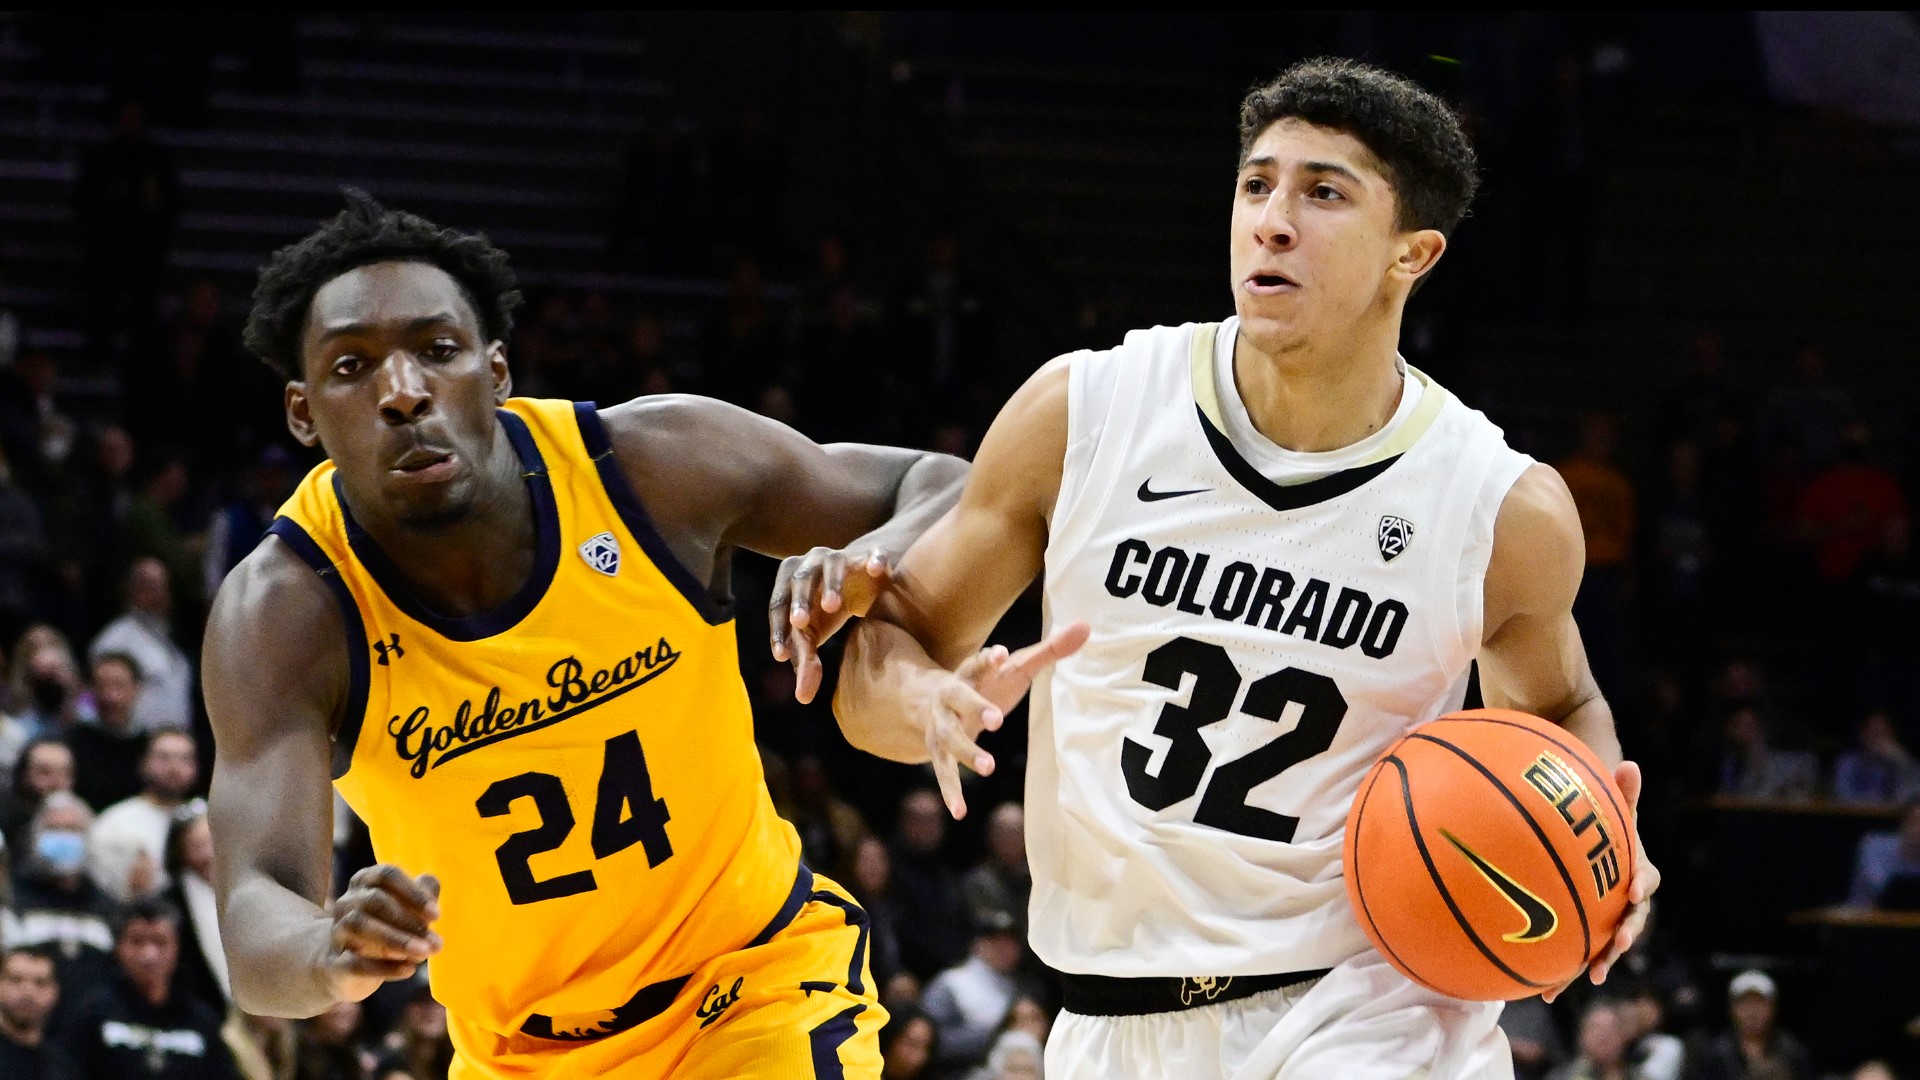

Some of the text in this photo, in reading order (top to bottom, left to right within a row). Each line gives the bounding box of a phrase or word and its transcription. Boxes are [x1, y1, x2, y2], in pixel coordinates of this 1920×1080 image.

[1380, 516, 1414, 548] PAC
[1381, 535, 1402, 555] 12
[1104, 538, 1409, 659] COLORADO
[388, 637, 681, 779] Golden Bears
[1121, 636, 1348, 844] 32
[475, 729, 674, 905] 24
[1521, 753, 1621, 902] ELITE
[696, 976, 744, 1020] Cal
